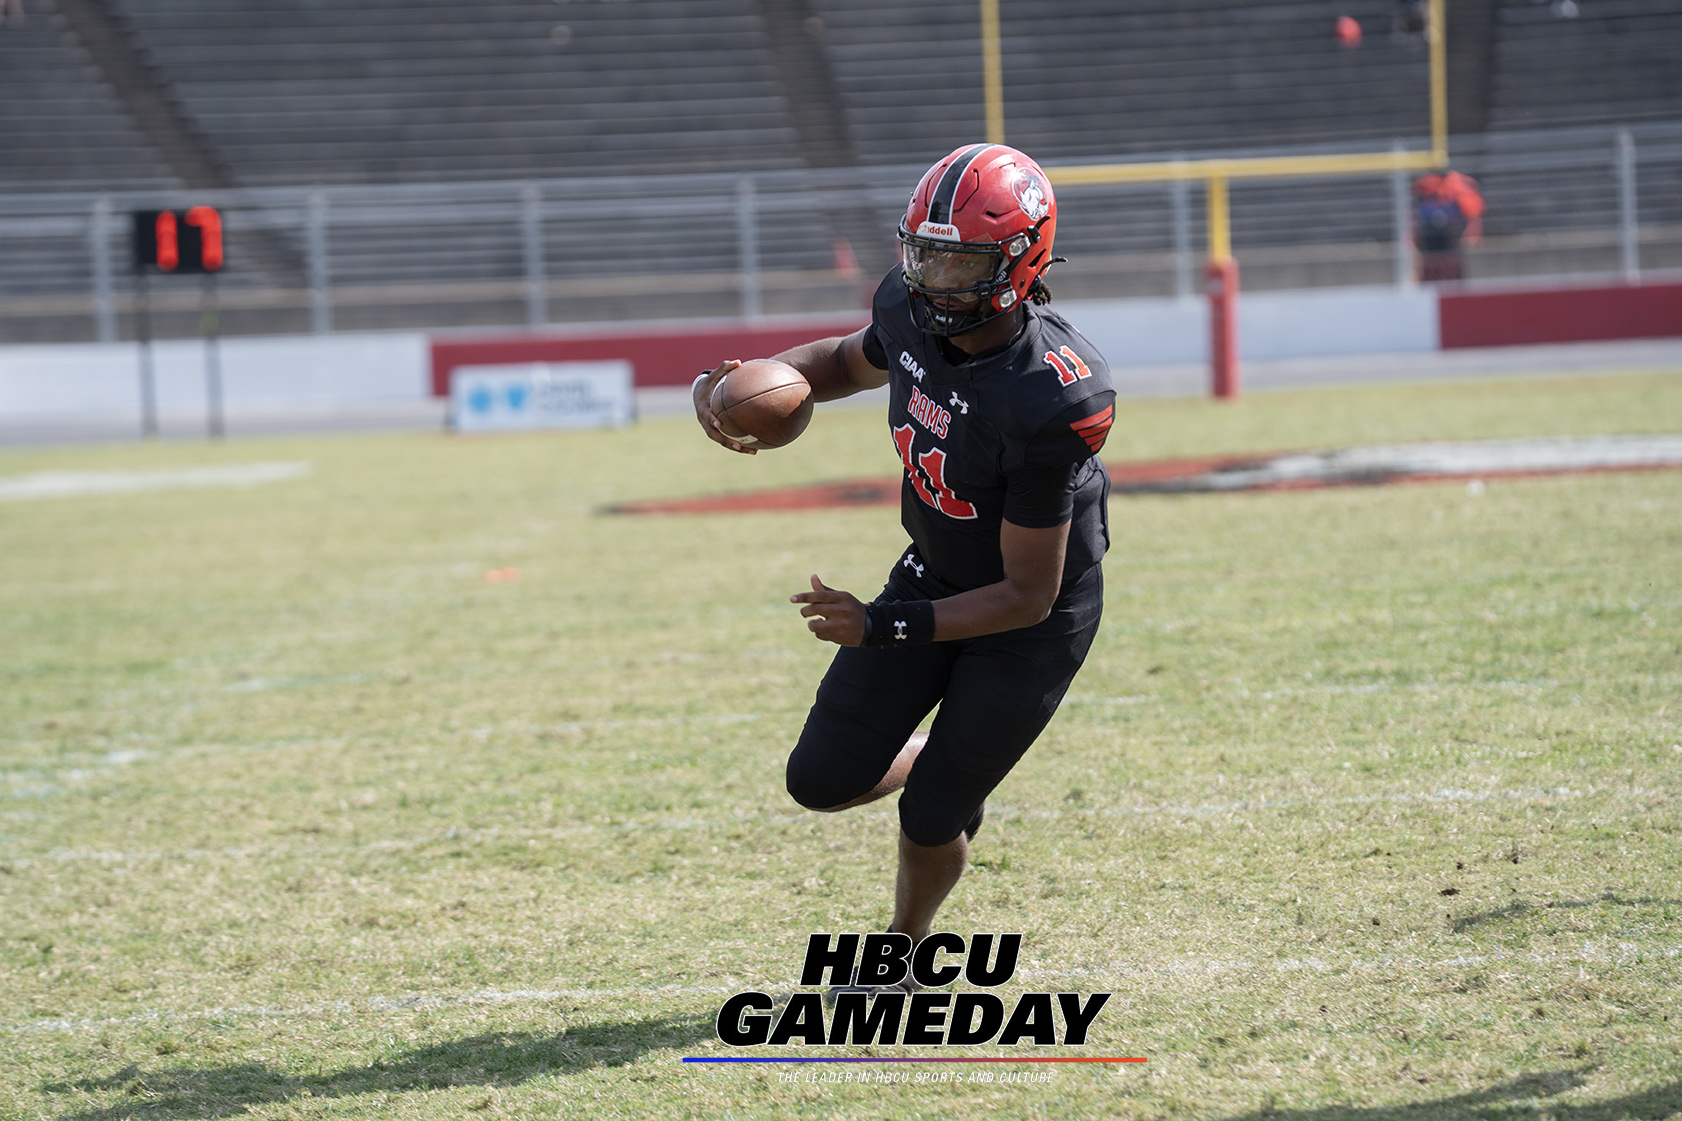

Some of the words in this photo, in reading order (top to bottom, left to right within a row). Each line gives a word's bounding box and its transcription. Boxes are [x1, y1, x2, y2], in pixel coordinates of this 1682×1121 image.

[899, 351, 924, 383] CIAA
[1043, 345, 1092, 387] 11
[907, 385, 952, 440] RAMS
[893, 423, 978, 519] 11
